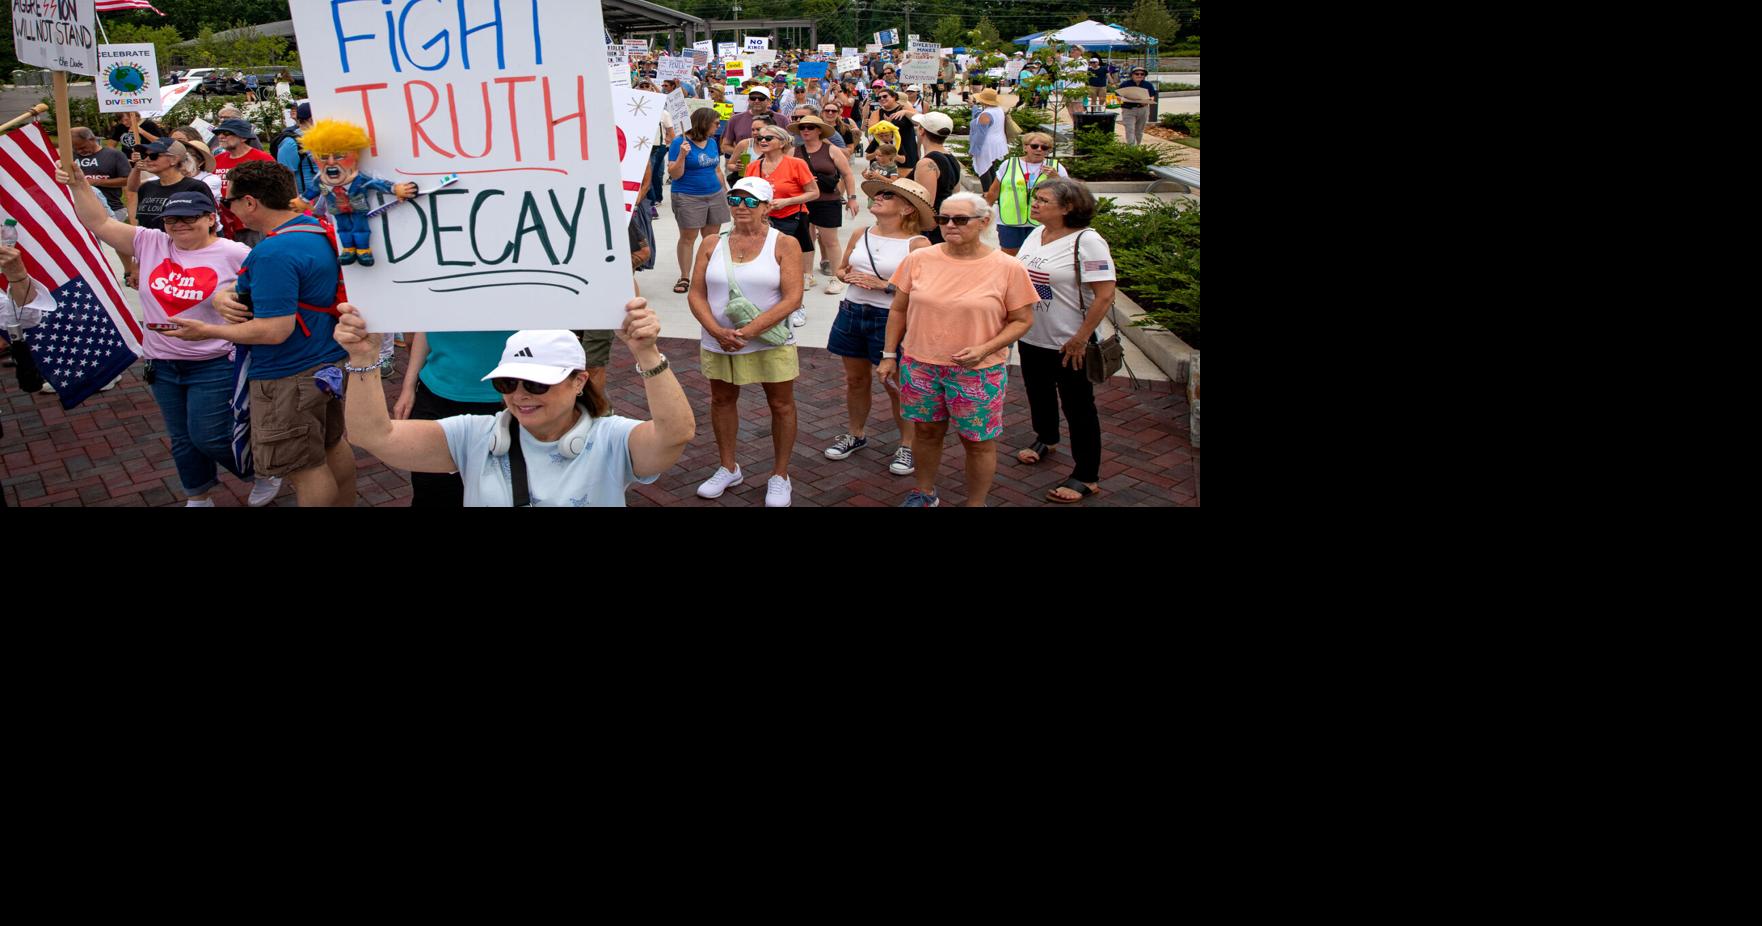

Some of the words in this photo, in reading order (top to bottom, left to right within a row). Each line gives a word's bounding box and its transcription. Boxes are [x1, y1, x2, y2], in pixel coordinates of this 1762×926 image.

[14, 18, 36, 41] WILL
[36, 20, 54, 43] NOT
[56, 22, 92, 49] STAND
[335, 75, 589, 162] TRUTH
[376, 183, 616, 267] DECAY!
[150, 276, 204, 300] Scum
[168, 270, 195, 287] I'm
